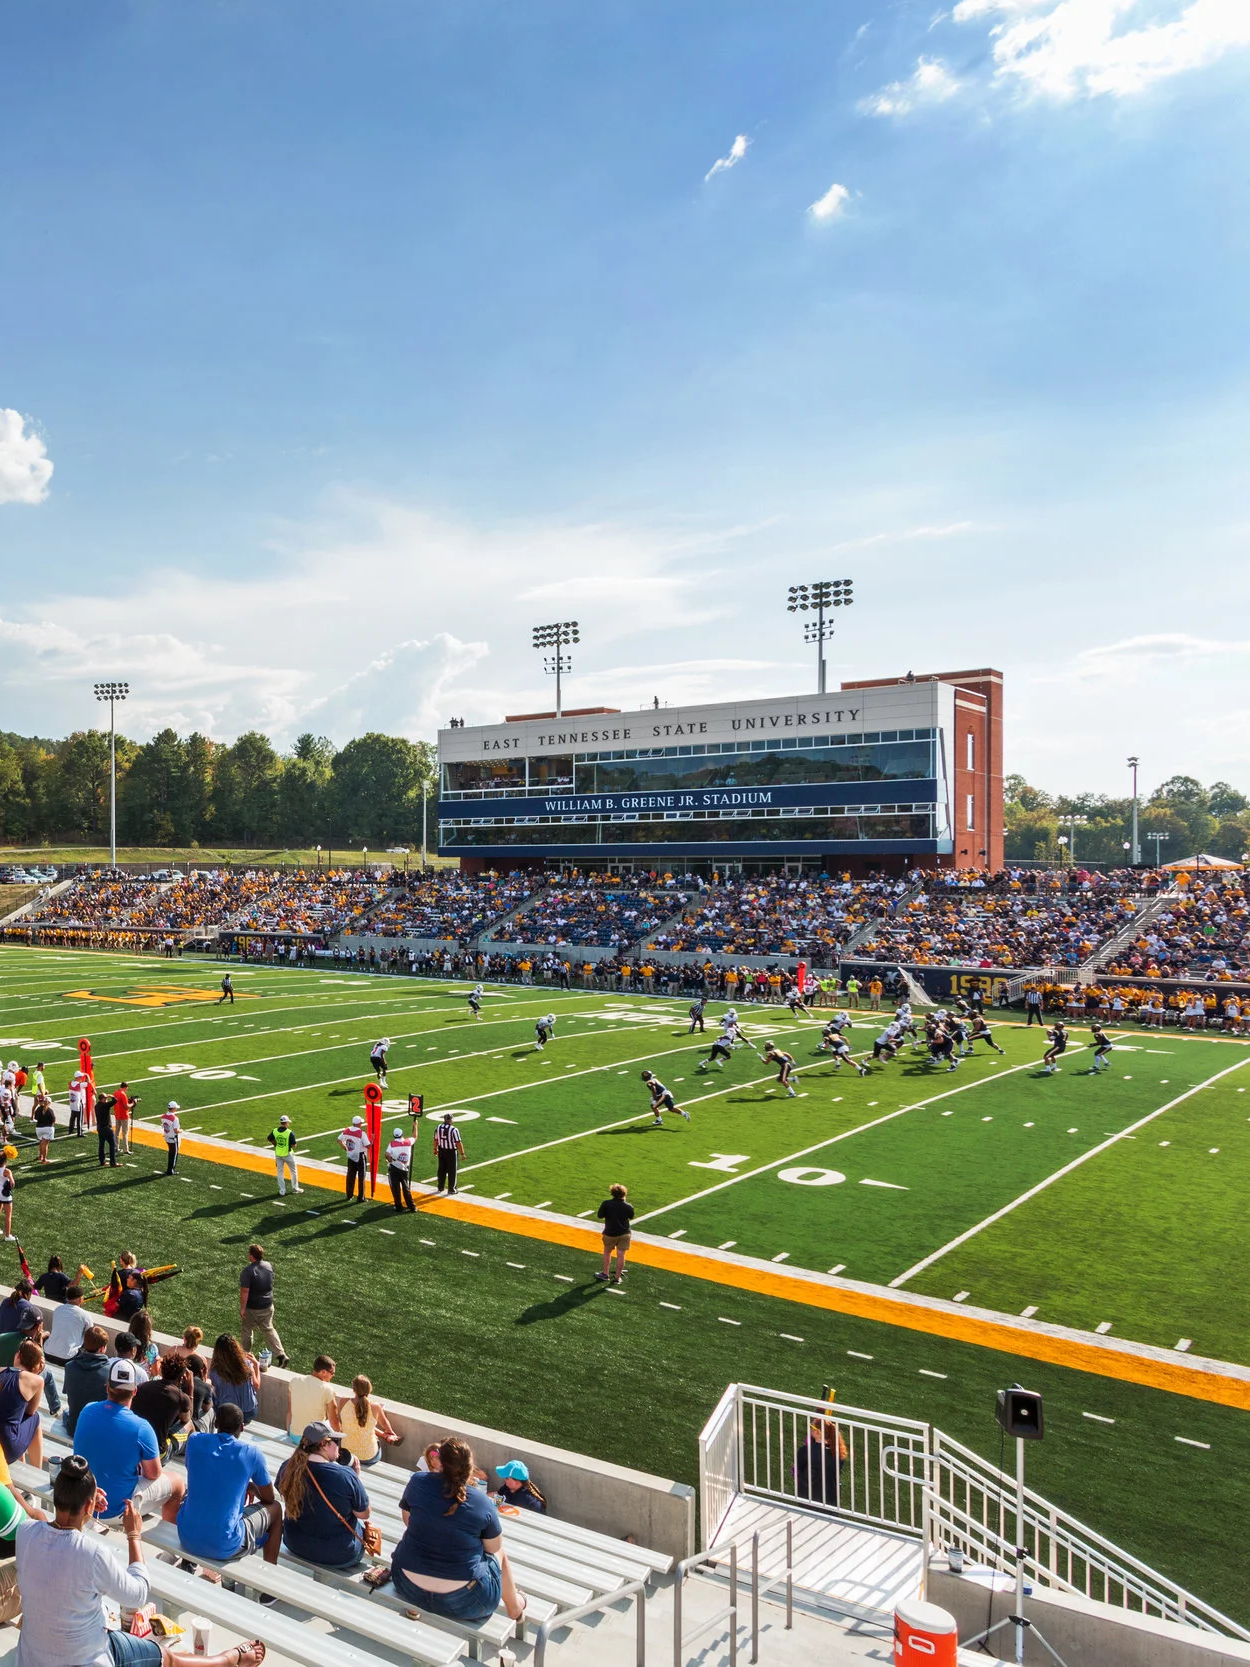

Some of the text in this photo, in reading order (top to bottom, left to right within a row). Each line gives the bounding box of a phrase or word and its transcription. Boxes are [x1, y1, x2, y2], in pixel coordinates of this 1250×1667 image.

[483, 709, 860, 750] EAST TENNESSEE STATE UNIVERSITY
[545, 792, 772, 811] WILLIAM B. GREENE JR. STADIUM
[411, 1096, 421, 1113] 2
[687, 1153, 846, 1186] 10
